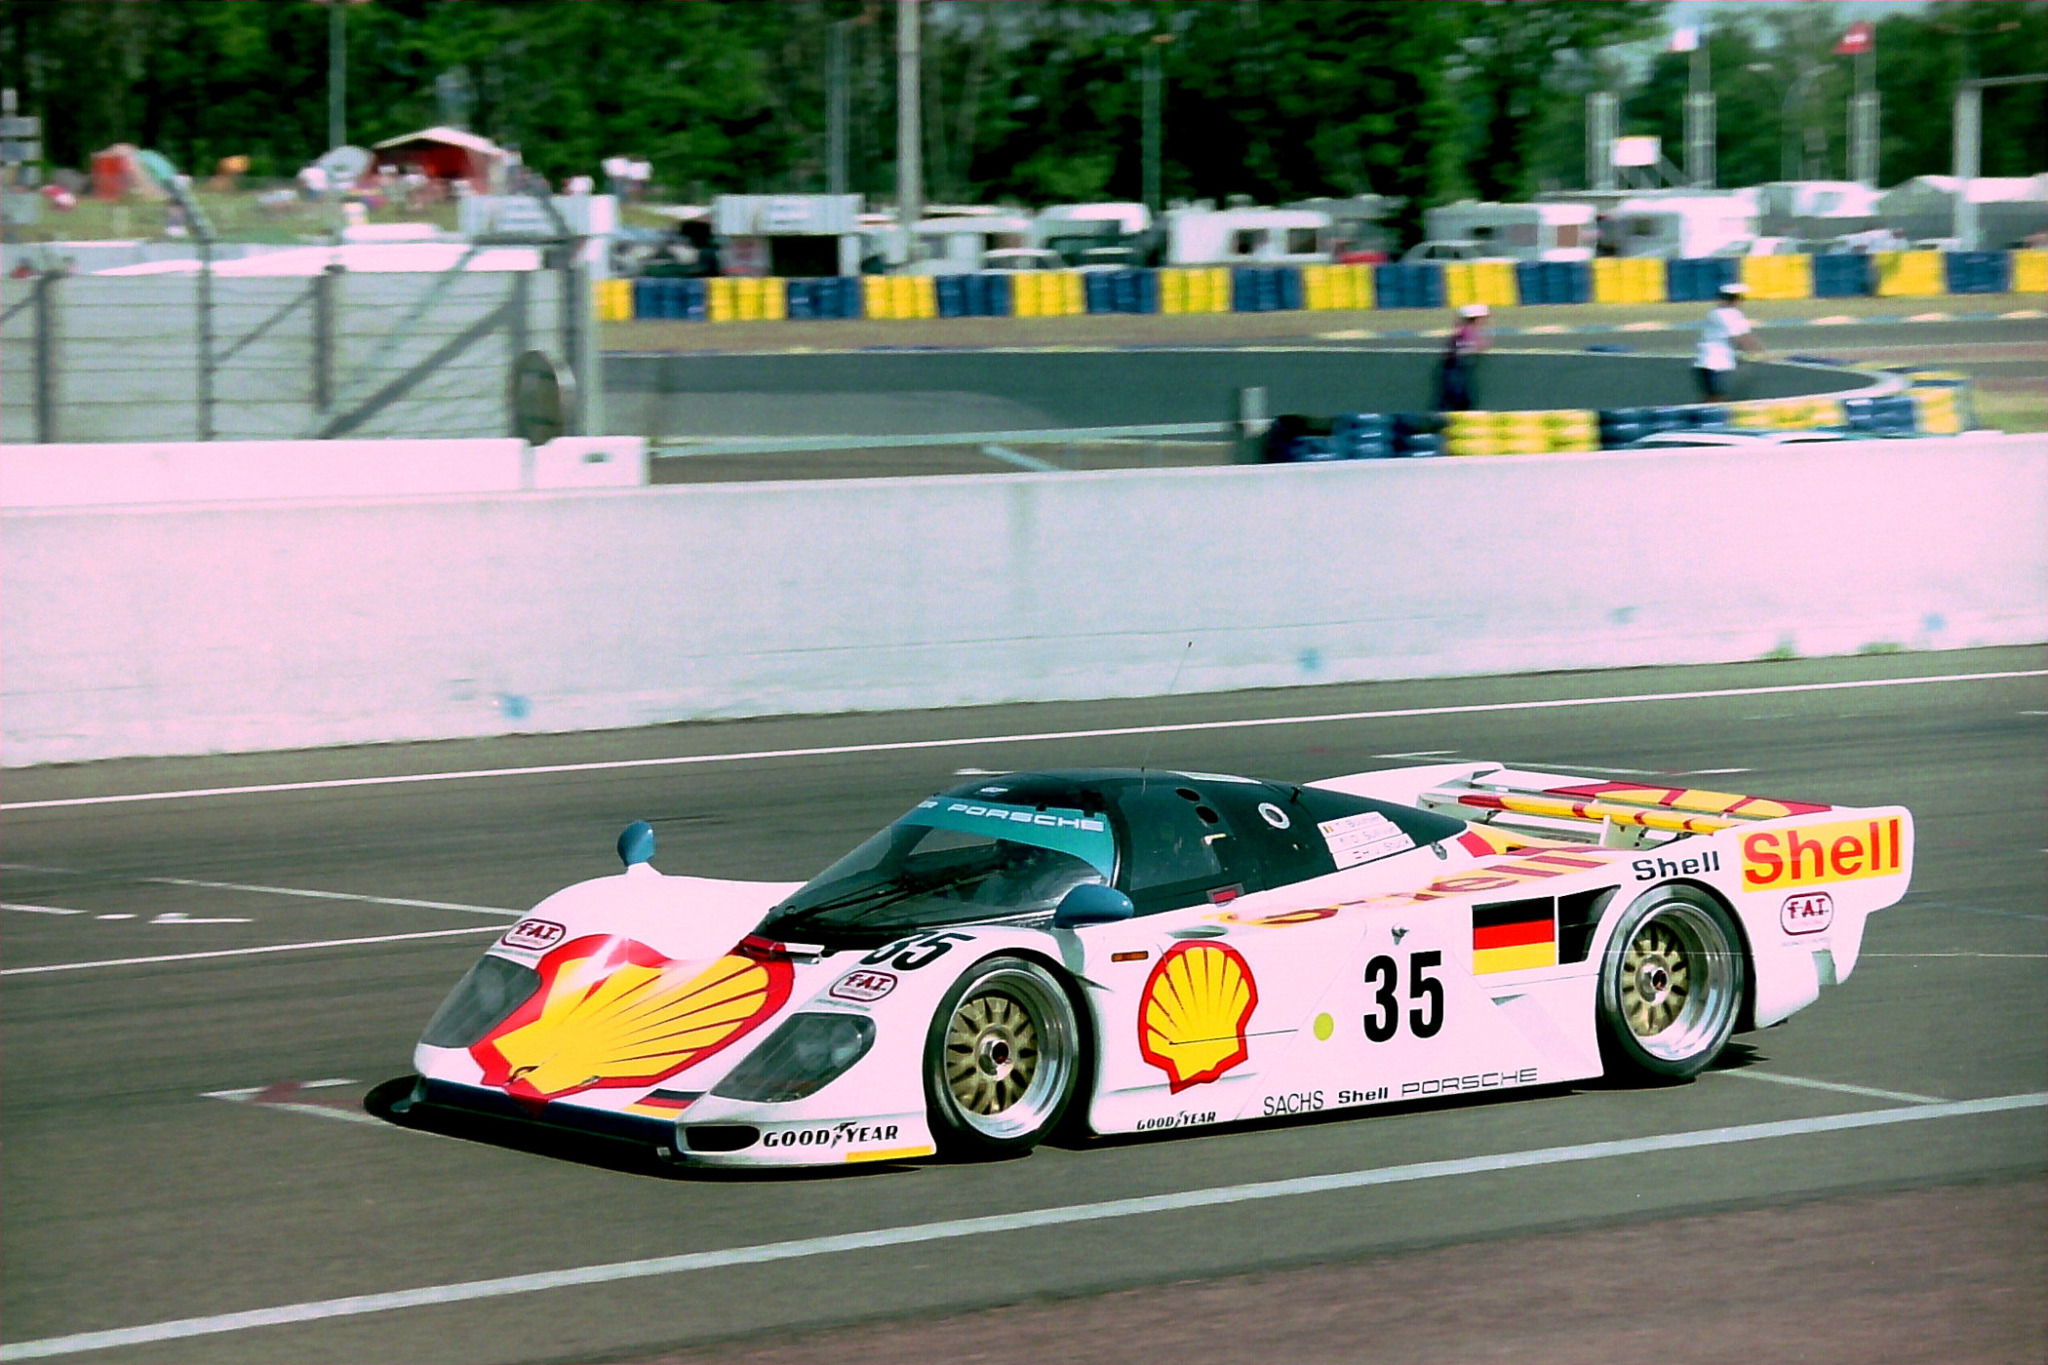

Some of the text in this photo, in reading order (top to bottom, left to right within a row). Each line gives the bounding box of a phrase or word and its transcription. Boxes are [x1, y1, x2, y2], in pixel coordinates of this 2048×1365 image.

[948, 803, 1104, 833] PORSCHE
[1632, 851, 1720, 881] Shell
[1744, 819, 1899, 885] Shell
[859, 931, 977, 971] 35
[1364, 950, 1444, 1043] 35
[1263, 1068, 1538, 1116] SACHS Shell PORSCHE
[763, 1122, 898, 1148] GOODYEAR
[1136, 1110, 1216, 1131] GOODYEAR
